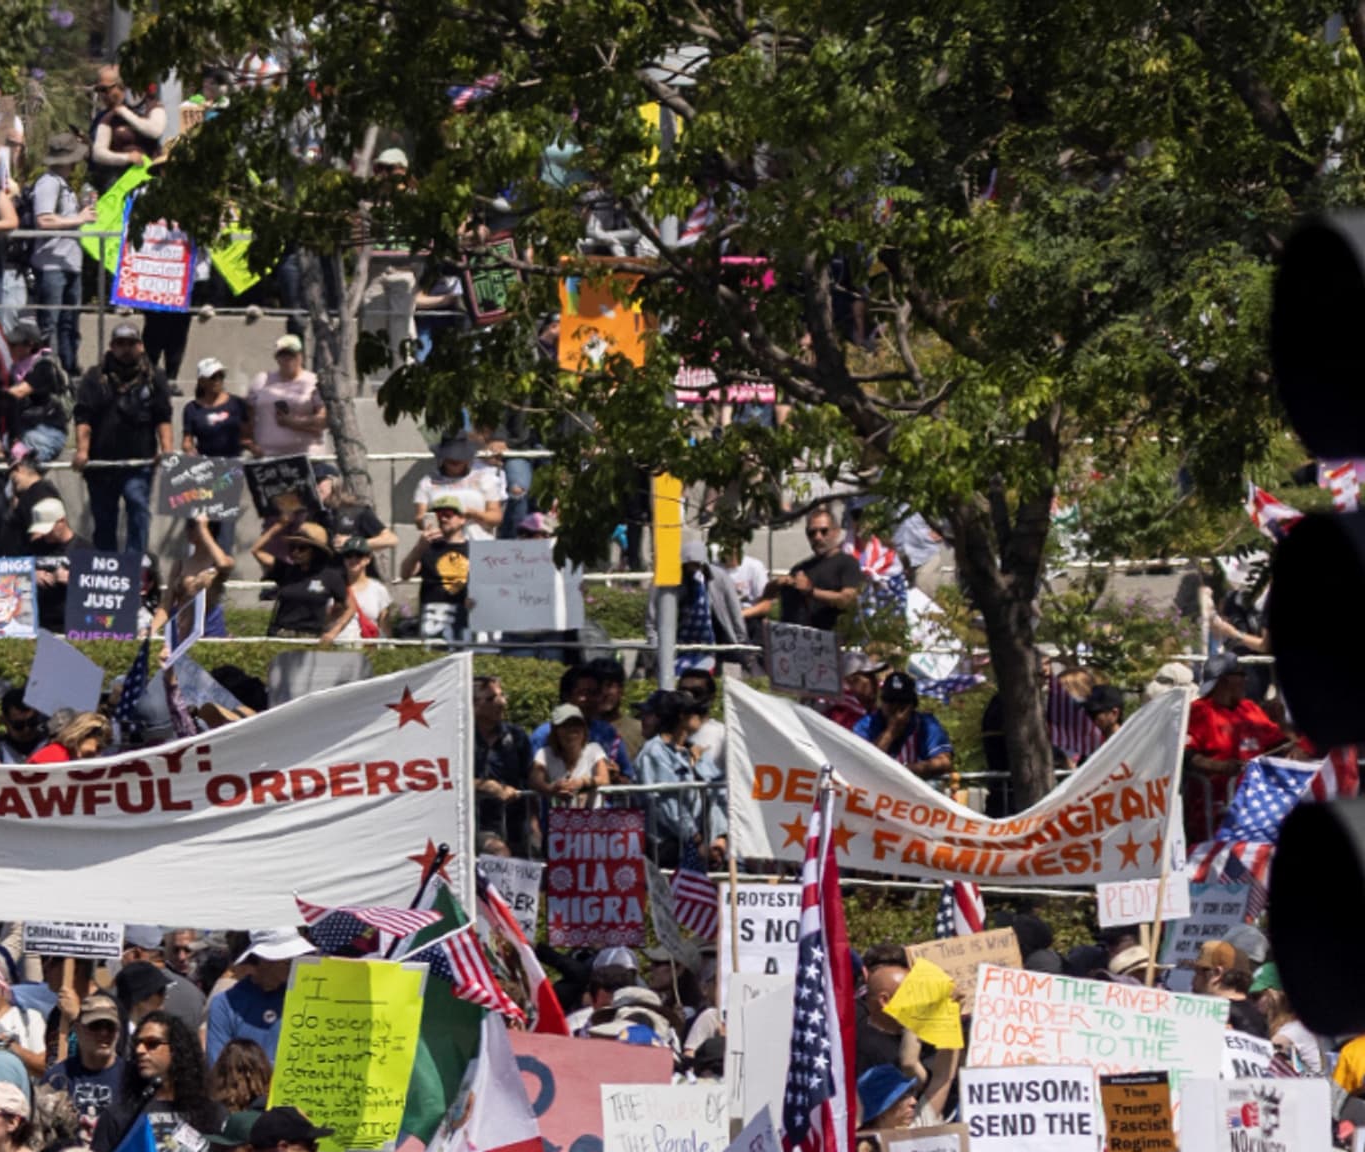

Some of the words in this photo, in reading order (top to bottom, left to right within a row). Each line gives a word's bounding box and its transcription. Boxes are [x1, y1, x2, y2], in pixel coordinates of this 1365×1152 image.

[92, 557, 118, 571] NO
[79, 574, 131, 592] KINGS
[83, 594, 125, 609] JUST
[205, 757, 453, 807] ORDERS!
[548, 832, 643, 860] CHINGA
[873, 829, 1102, 877] FAMILIES!
[577, 863, 609, 892] LA
[548, 896, 644, 924] MIGRA
[982, 967, 1053, 1000] FROM
[1057, 978, 1105, 1006] THE
[1106, 983, 1169, 1013] RIVER
[977, 996, 1090, 1028] BOARDER
[1094, 1010, 1125, 1030] TO
[974, 1020, 1069, 1049] CLOSET
[1078, 1030, 1116, 1056] TO
[969, 1080, 1089, 1104] NEWSOM:
[1114, 1102, 1161, 1117] Trump
[969, 1113, 1036, 1138] SEND
[1045, 1113, 1092, 1136] THE
[1110, 1118, 1169, 1132] Fascist
[1111, 1134, 1171, 1152] Regime
